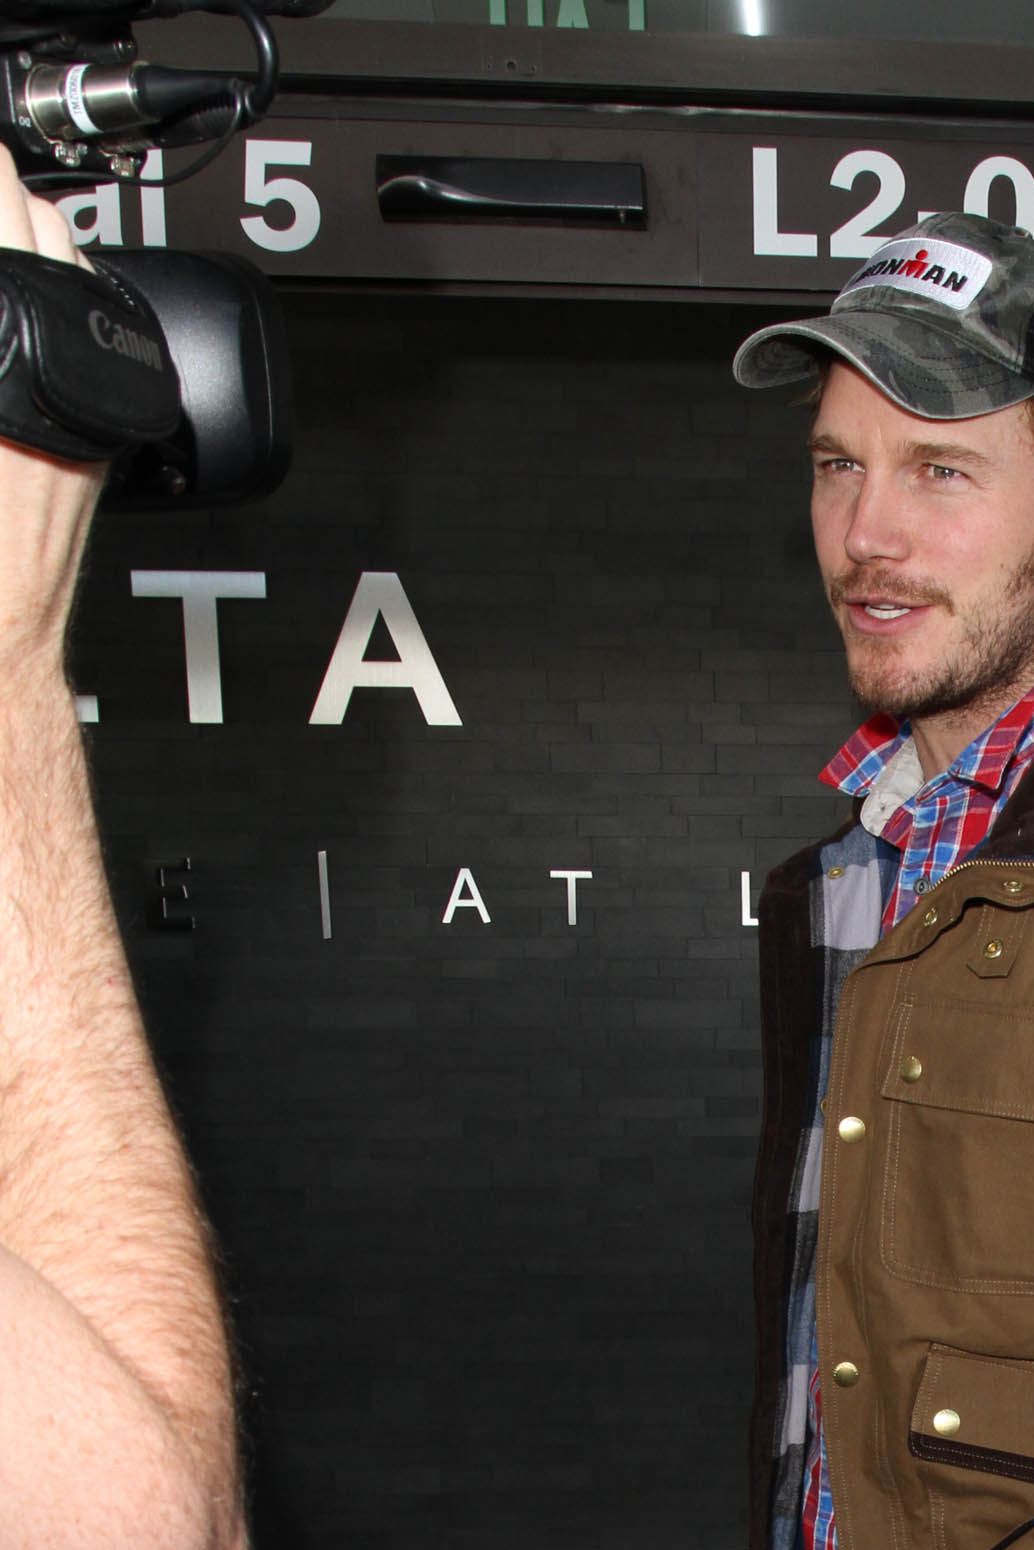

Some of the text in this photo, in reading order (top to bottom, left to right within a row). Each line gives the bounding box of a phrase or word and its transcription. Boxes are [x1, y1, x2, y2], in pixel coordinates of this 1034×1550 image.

[239, 138, 320, 252] 5
[88, 309, 163, 372] Canon
[76, 570, 463, 726] TA
[442, 868, 592, 926] AT
